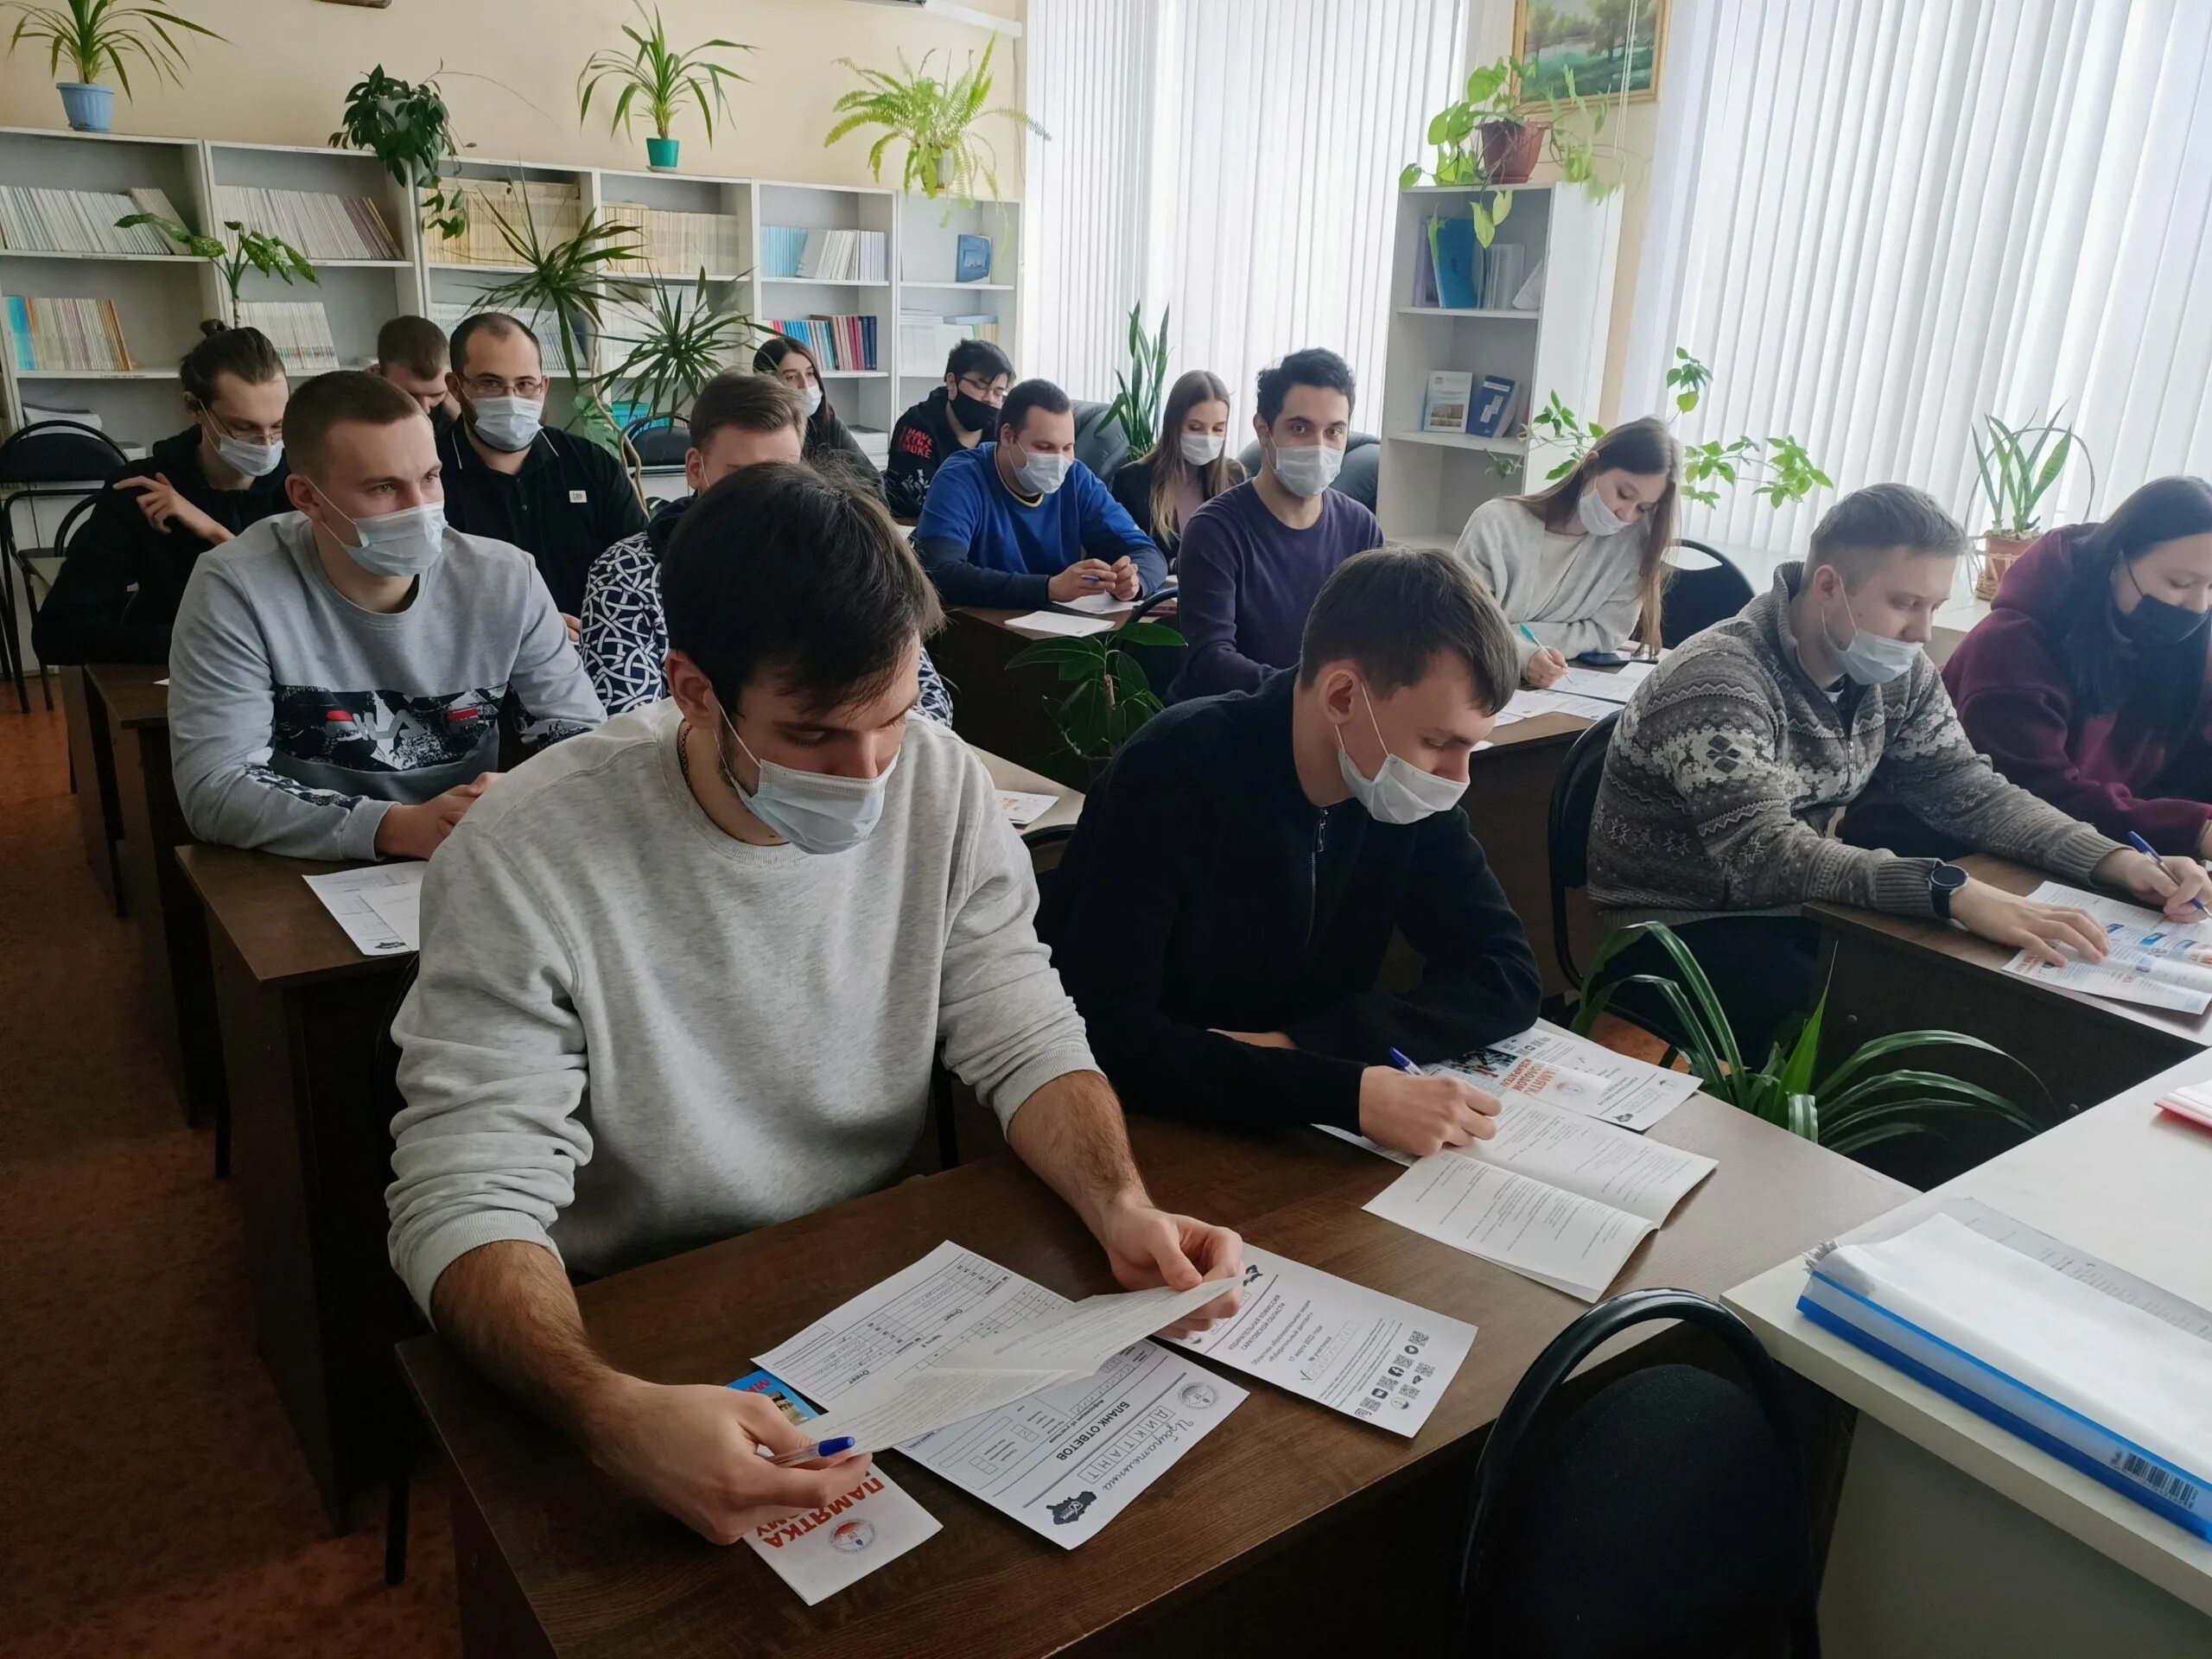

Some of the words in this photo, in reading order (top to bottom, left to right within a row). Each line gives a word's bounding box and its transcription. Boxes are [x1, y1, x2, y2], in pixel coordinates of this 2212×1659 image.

[325, 709, 430, 741] FILA
[1258, 1294, 1281, 1319] КОМИССИЯ
[1241, 1321, 1269, 1351] САРАТОВСКОЙ
[1266, 1301, 1286, 1324] ОБЛАСТИ
[849, 1370, 870, 1384] Ответ
[1097, 1401, 1131, 1427] БЛАНК
[1056, 1425, 1101, 1461] ОТВЕТОВ
[1087, 1409, 1169, 1480] ДИКТАНТ
[761, 1477, 886, 1548] ПАМЯТКА
